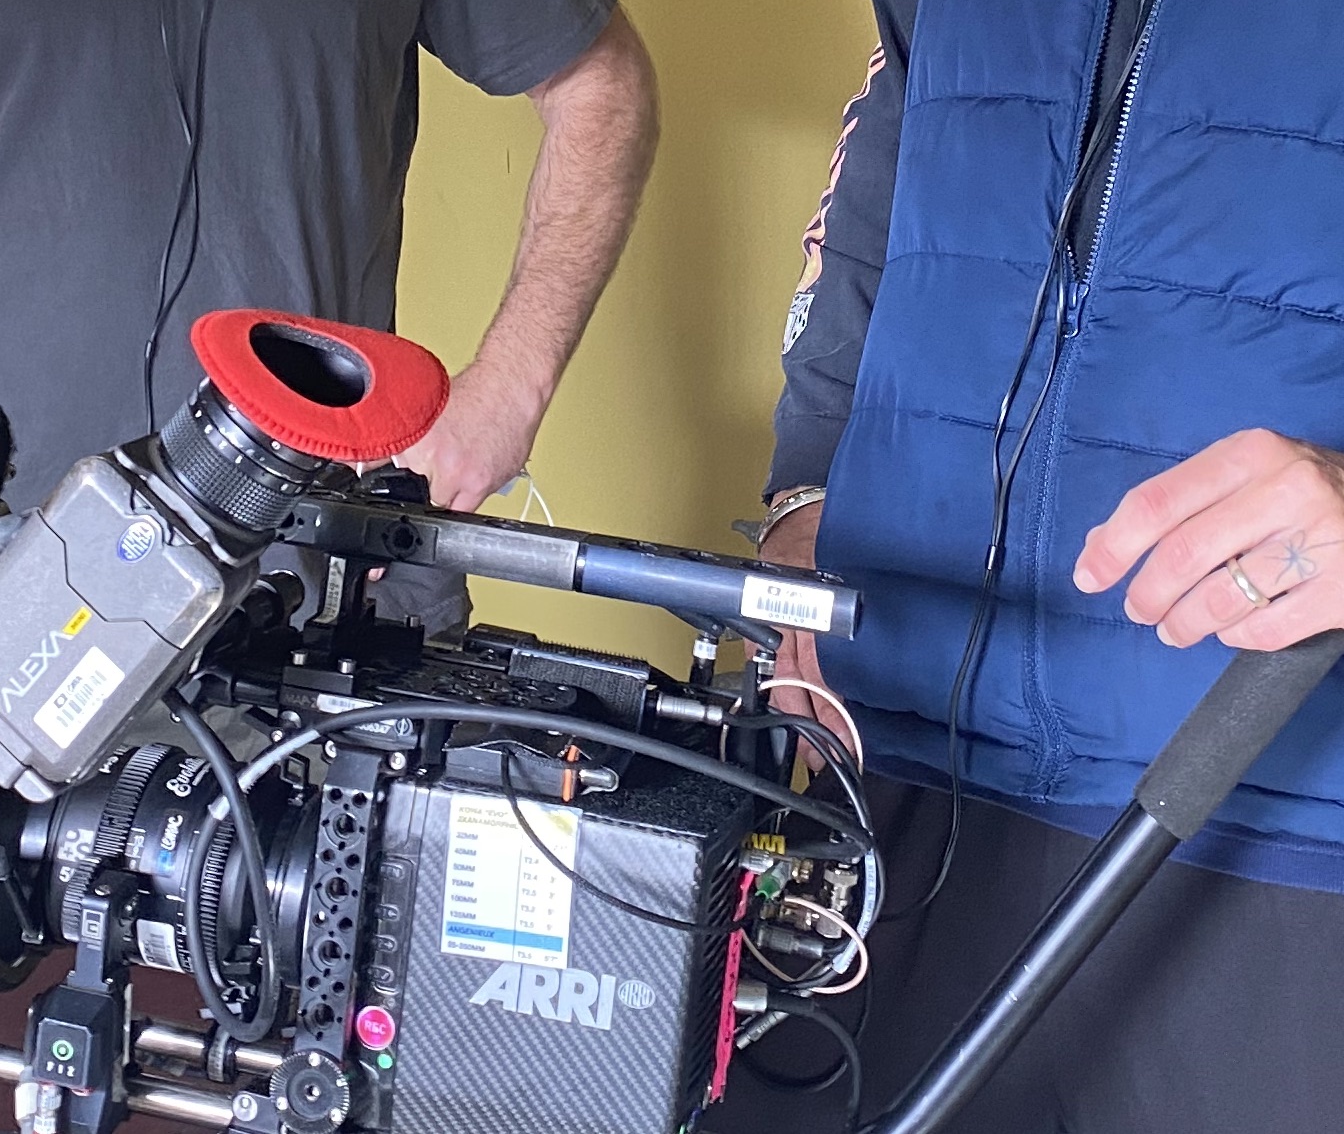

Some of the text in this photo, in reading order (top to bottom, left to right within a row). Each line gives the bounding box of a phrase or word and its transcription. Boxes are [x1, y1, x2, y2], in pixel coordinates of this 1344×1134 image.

[0, 629, 75, 714] ALEXA
[450, 894, 478, 904] 100MM
[448, 926, 495, 938] ANGENIEUX
[468, 963, 617, 1031] ARRI
[618, 979, 656, 1010] ARRI
[363, 1019, 387, 1035] REC
